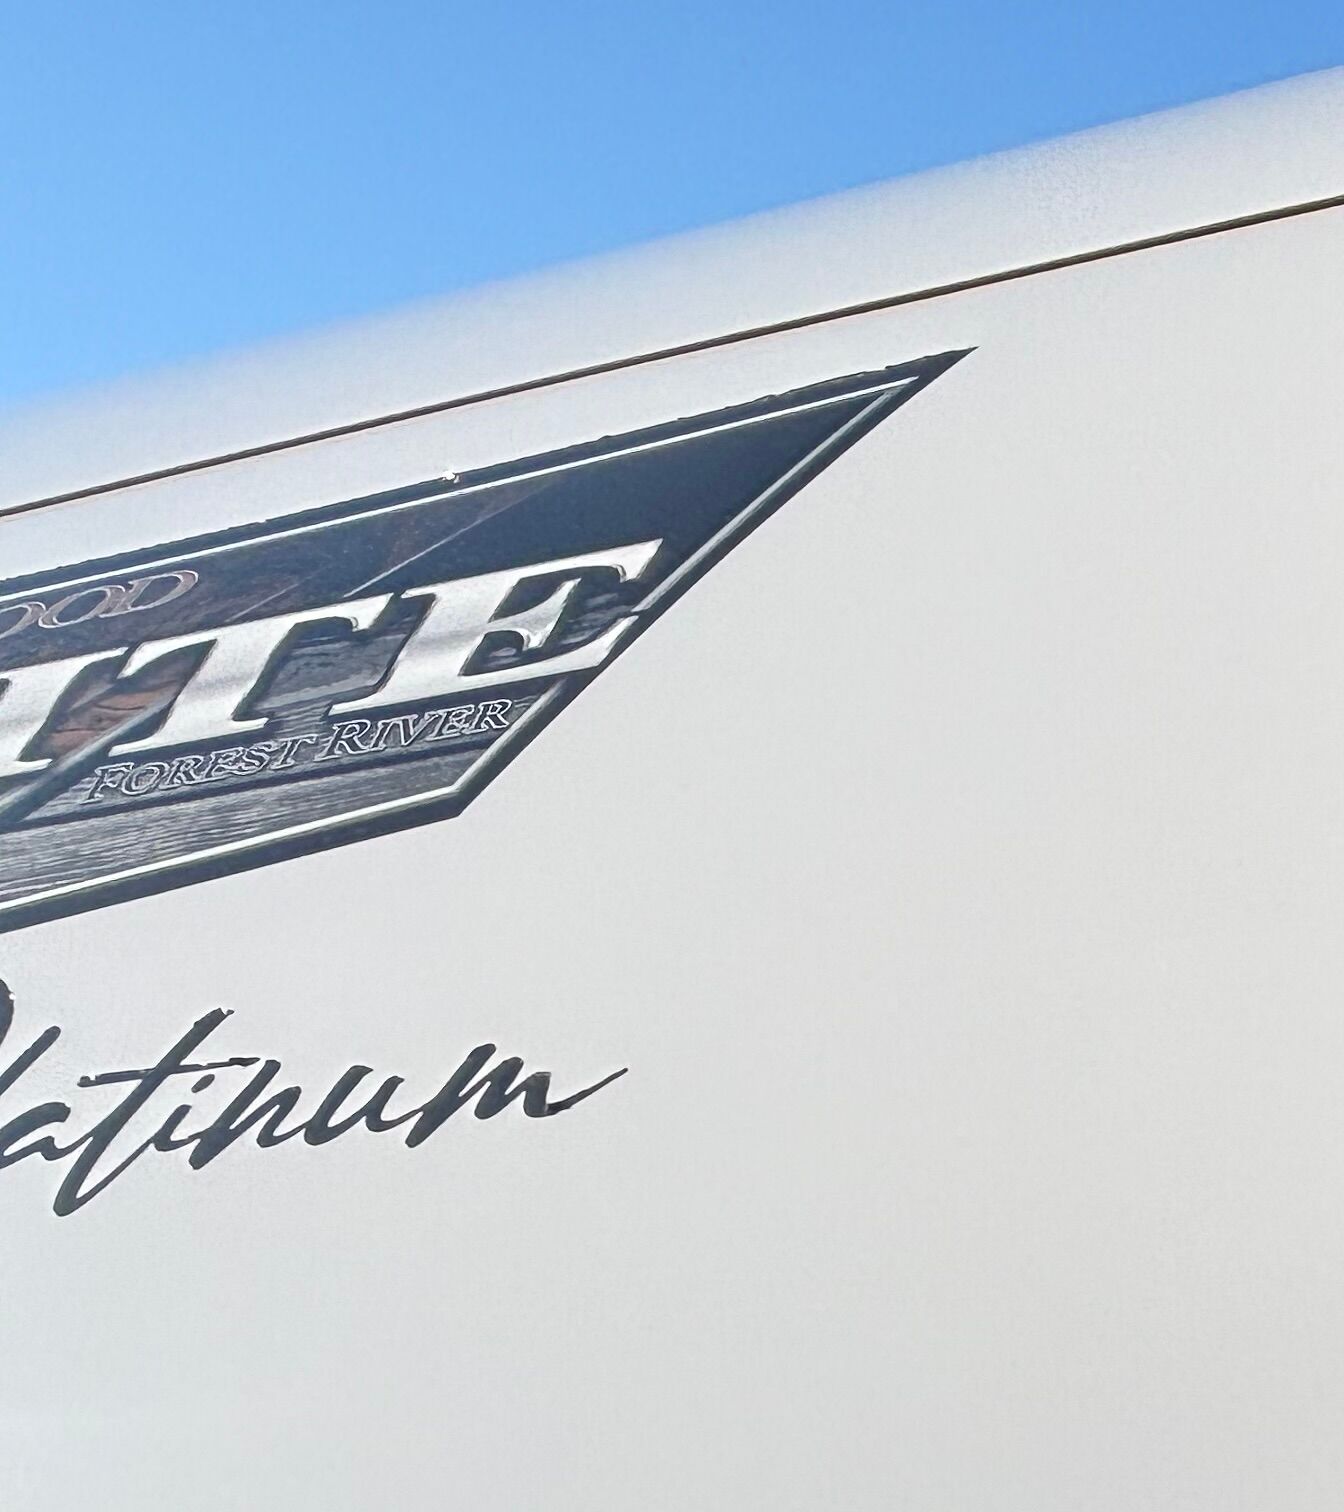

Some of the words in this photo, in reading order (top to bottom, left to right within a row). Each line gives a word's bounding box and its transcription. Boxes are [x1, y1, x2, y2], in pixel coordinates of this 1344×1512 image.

[79, 734, 319, 805] FOREST
[314, 698, 514, 762] RIVER
[0, 979, 629, 1218] latinum
